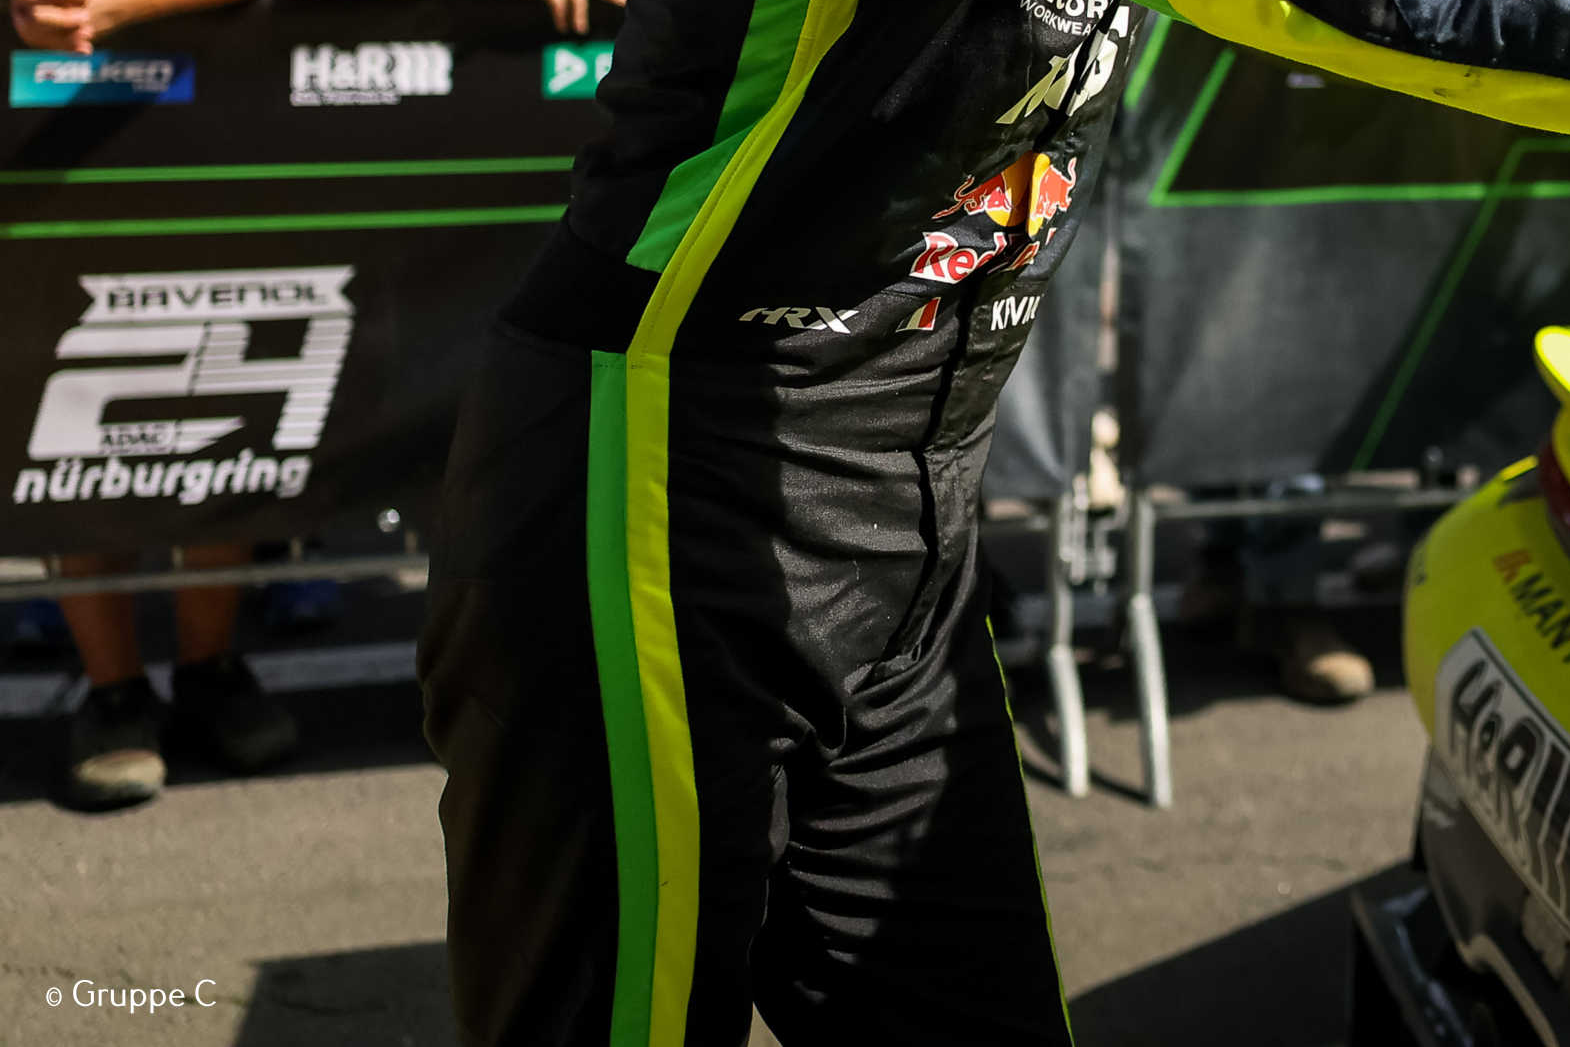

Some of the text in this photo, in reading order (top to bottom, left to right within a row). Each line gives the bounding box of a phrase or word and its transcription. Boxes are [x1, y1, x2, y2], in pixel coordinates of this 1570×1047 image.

[107, 282, 322, 311] RAVENOL
[738, 306, 860, 334] HRX
[13, 449, 312, 505] nürburgring
